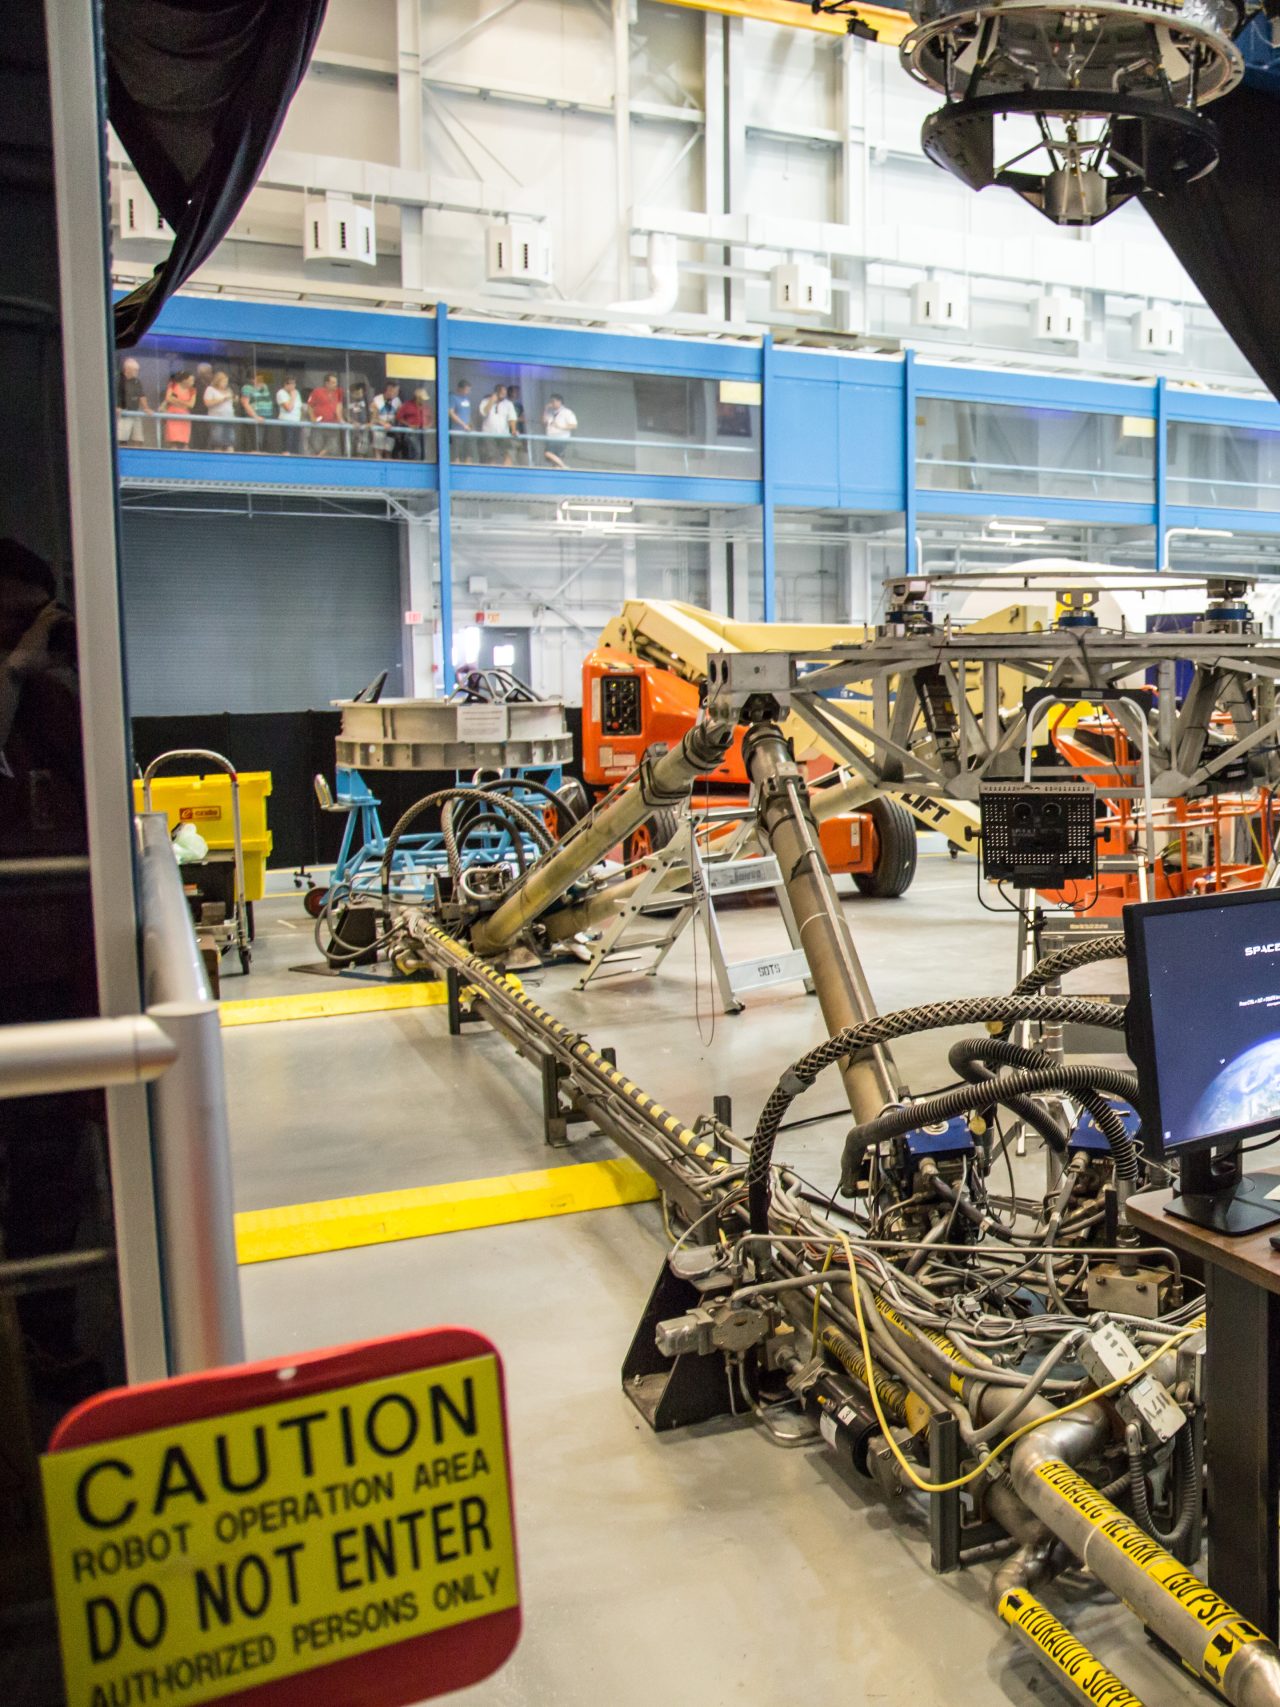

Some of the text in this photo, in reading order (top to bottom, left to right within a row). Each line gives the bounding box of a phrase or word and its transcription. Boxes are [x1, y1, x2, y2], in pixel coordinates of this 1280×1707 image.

[72, 1448, 490, 1582] ROBOT OPERATION AREA
[75, 1377, 479, 1530] CAUTION
[85, 1496, 494, 1664] DO NOT ENTER
[1040, 1463, 1119, 1520] HYDRAULIC
[1101, 1518, 1166, 1565] RETURN
[1186, 1594, 1237, 1626] PSI
[88, 1568, 501, 1707] AUTHORIZED PERSONS ONLY
[1018, 1605, 1097, 1676] HYDRAULIC
